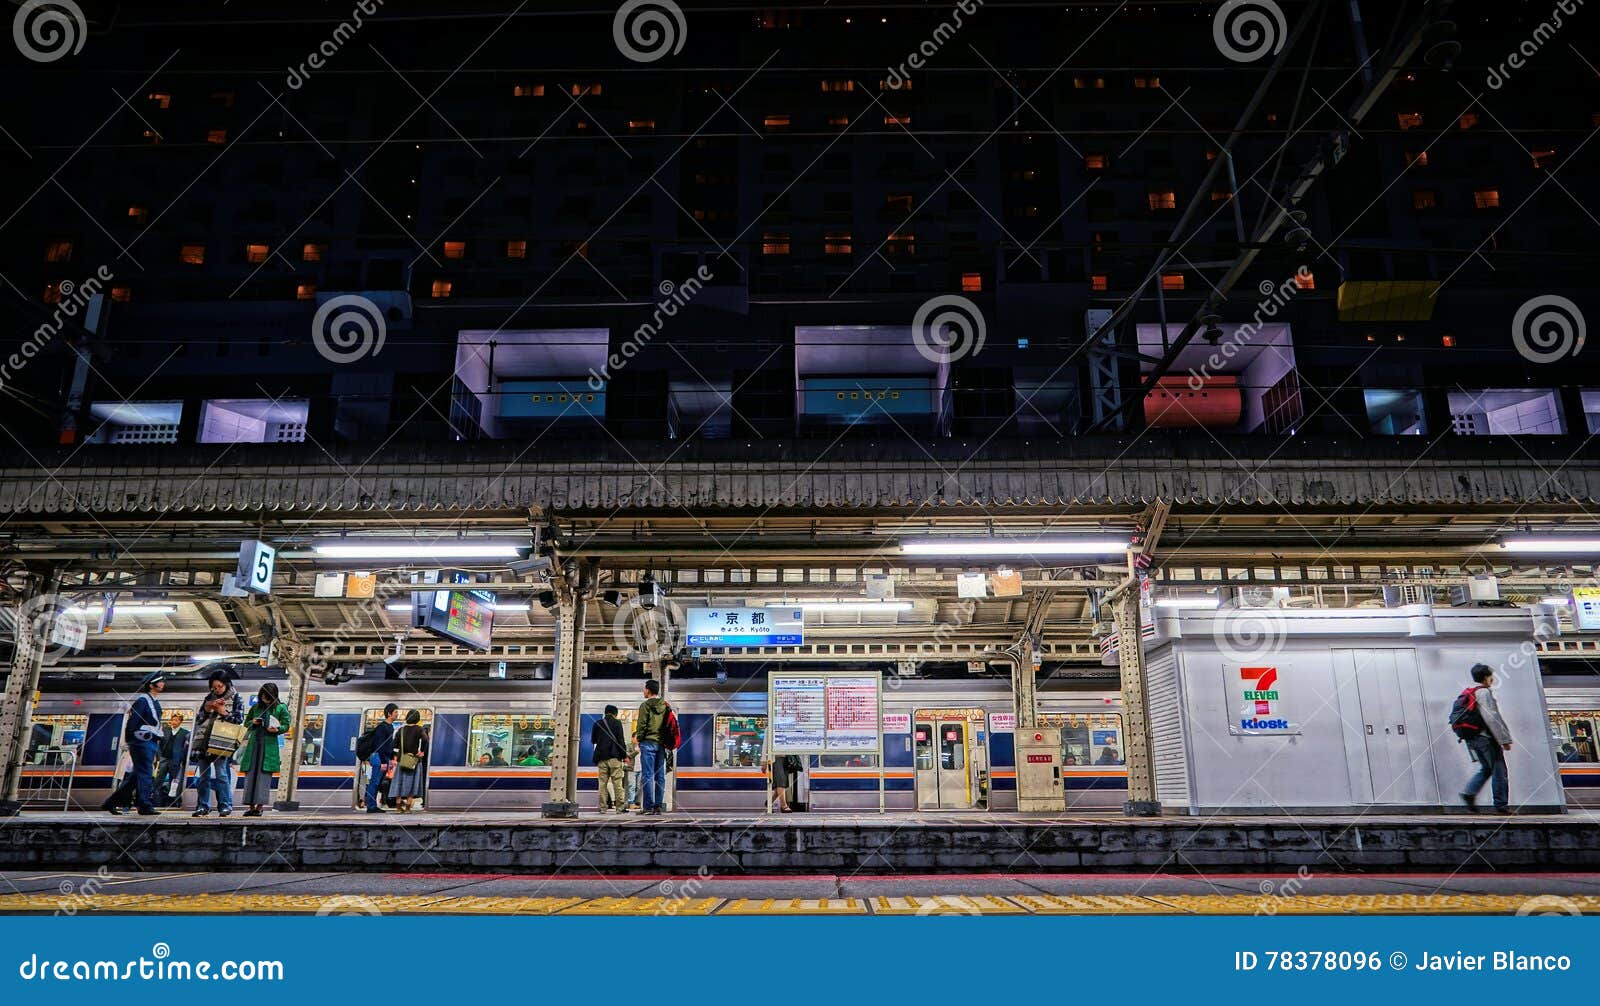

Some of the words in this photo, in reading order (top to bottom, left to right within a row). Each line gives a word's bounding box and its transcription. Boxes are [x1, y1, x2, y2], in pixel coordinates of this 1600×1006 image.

[256, 551, 270, 583] 5
[725, 612, 765, 625] 京都
[1241, 717, 1289, 729] Kiosk
